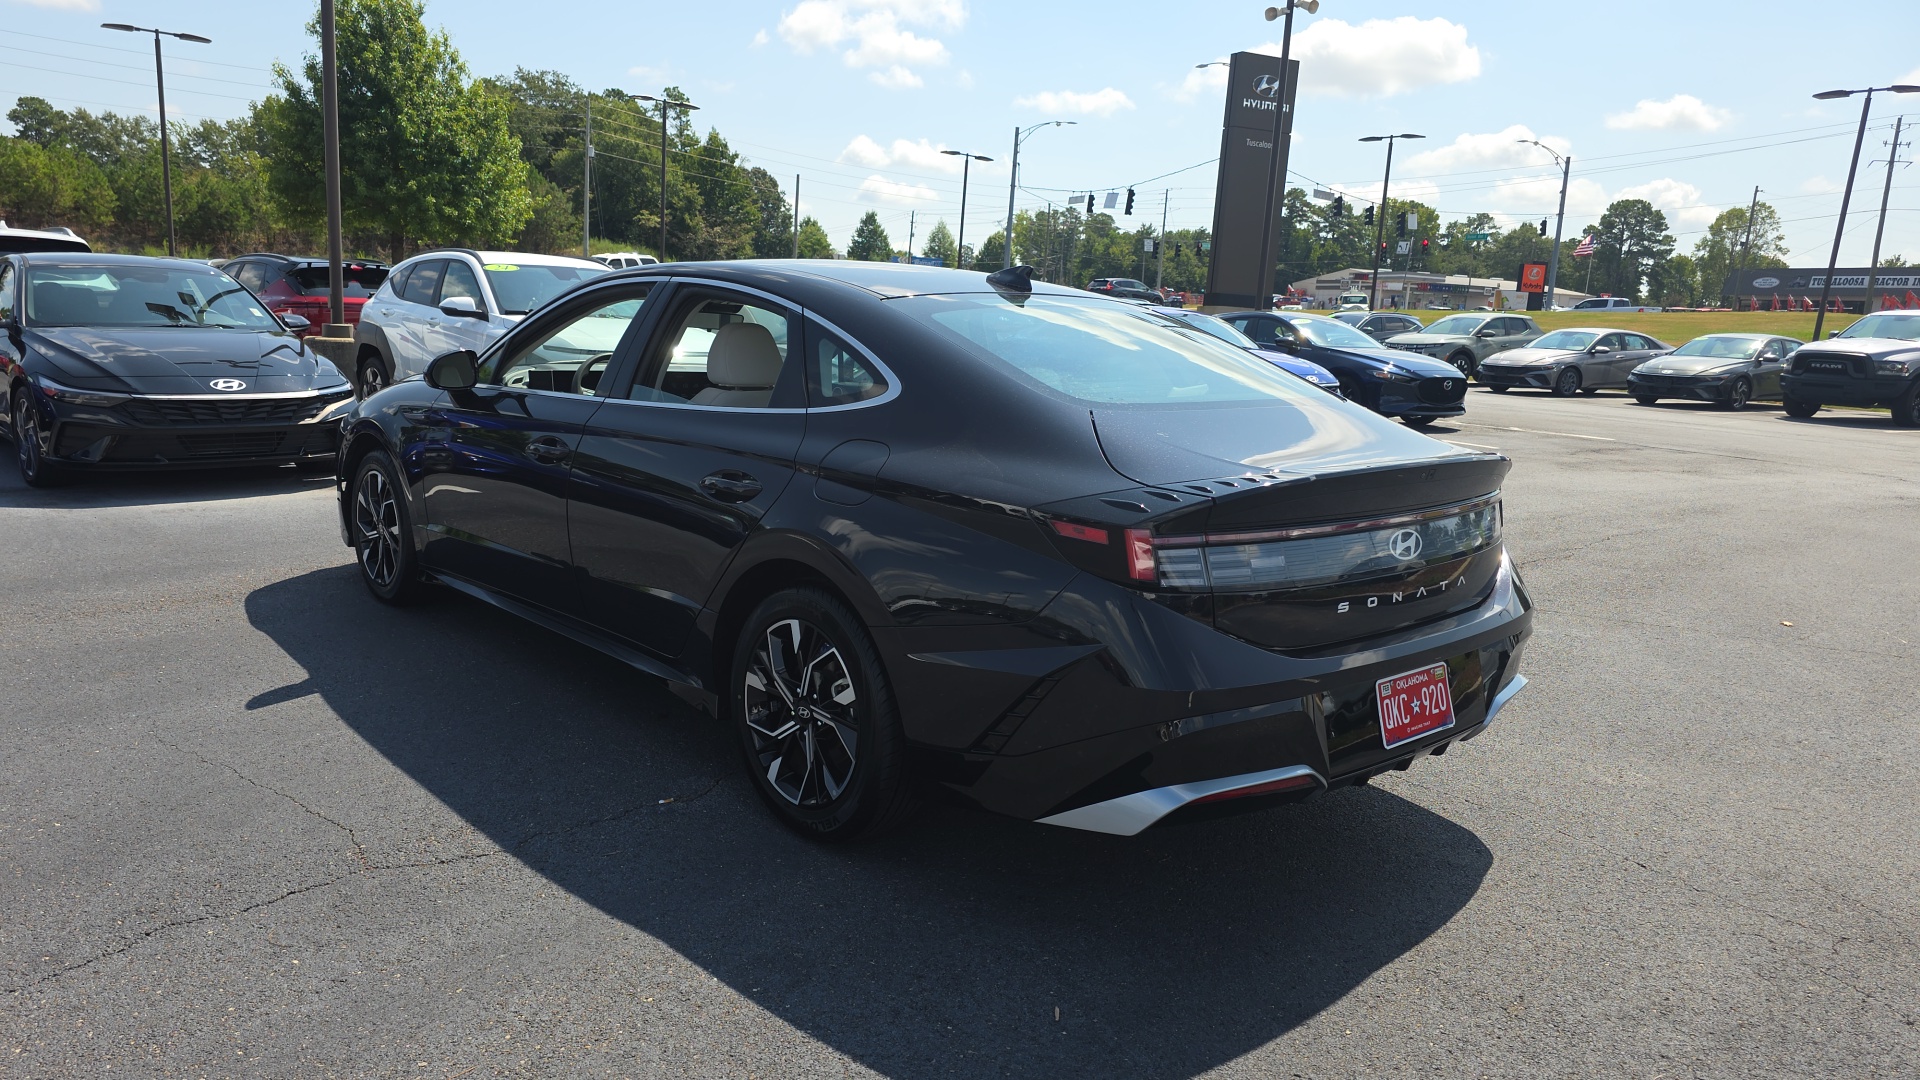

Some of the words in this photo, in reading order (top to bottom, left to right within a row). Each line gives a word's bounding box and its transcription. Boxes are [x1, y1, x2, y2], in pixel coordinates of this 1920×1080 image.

[1811, 277, 1866, 286] TUSALOOSA
[1874, 277, 1909, 286] RACTOR
[1337, 575, 1466, 613] SONATA
[1396, 673, 1429, 689] OKLAHOMA
[1383, 693, 1410, 729] QKC
[1421, 682, 1447, 716] 920
